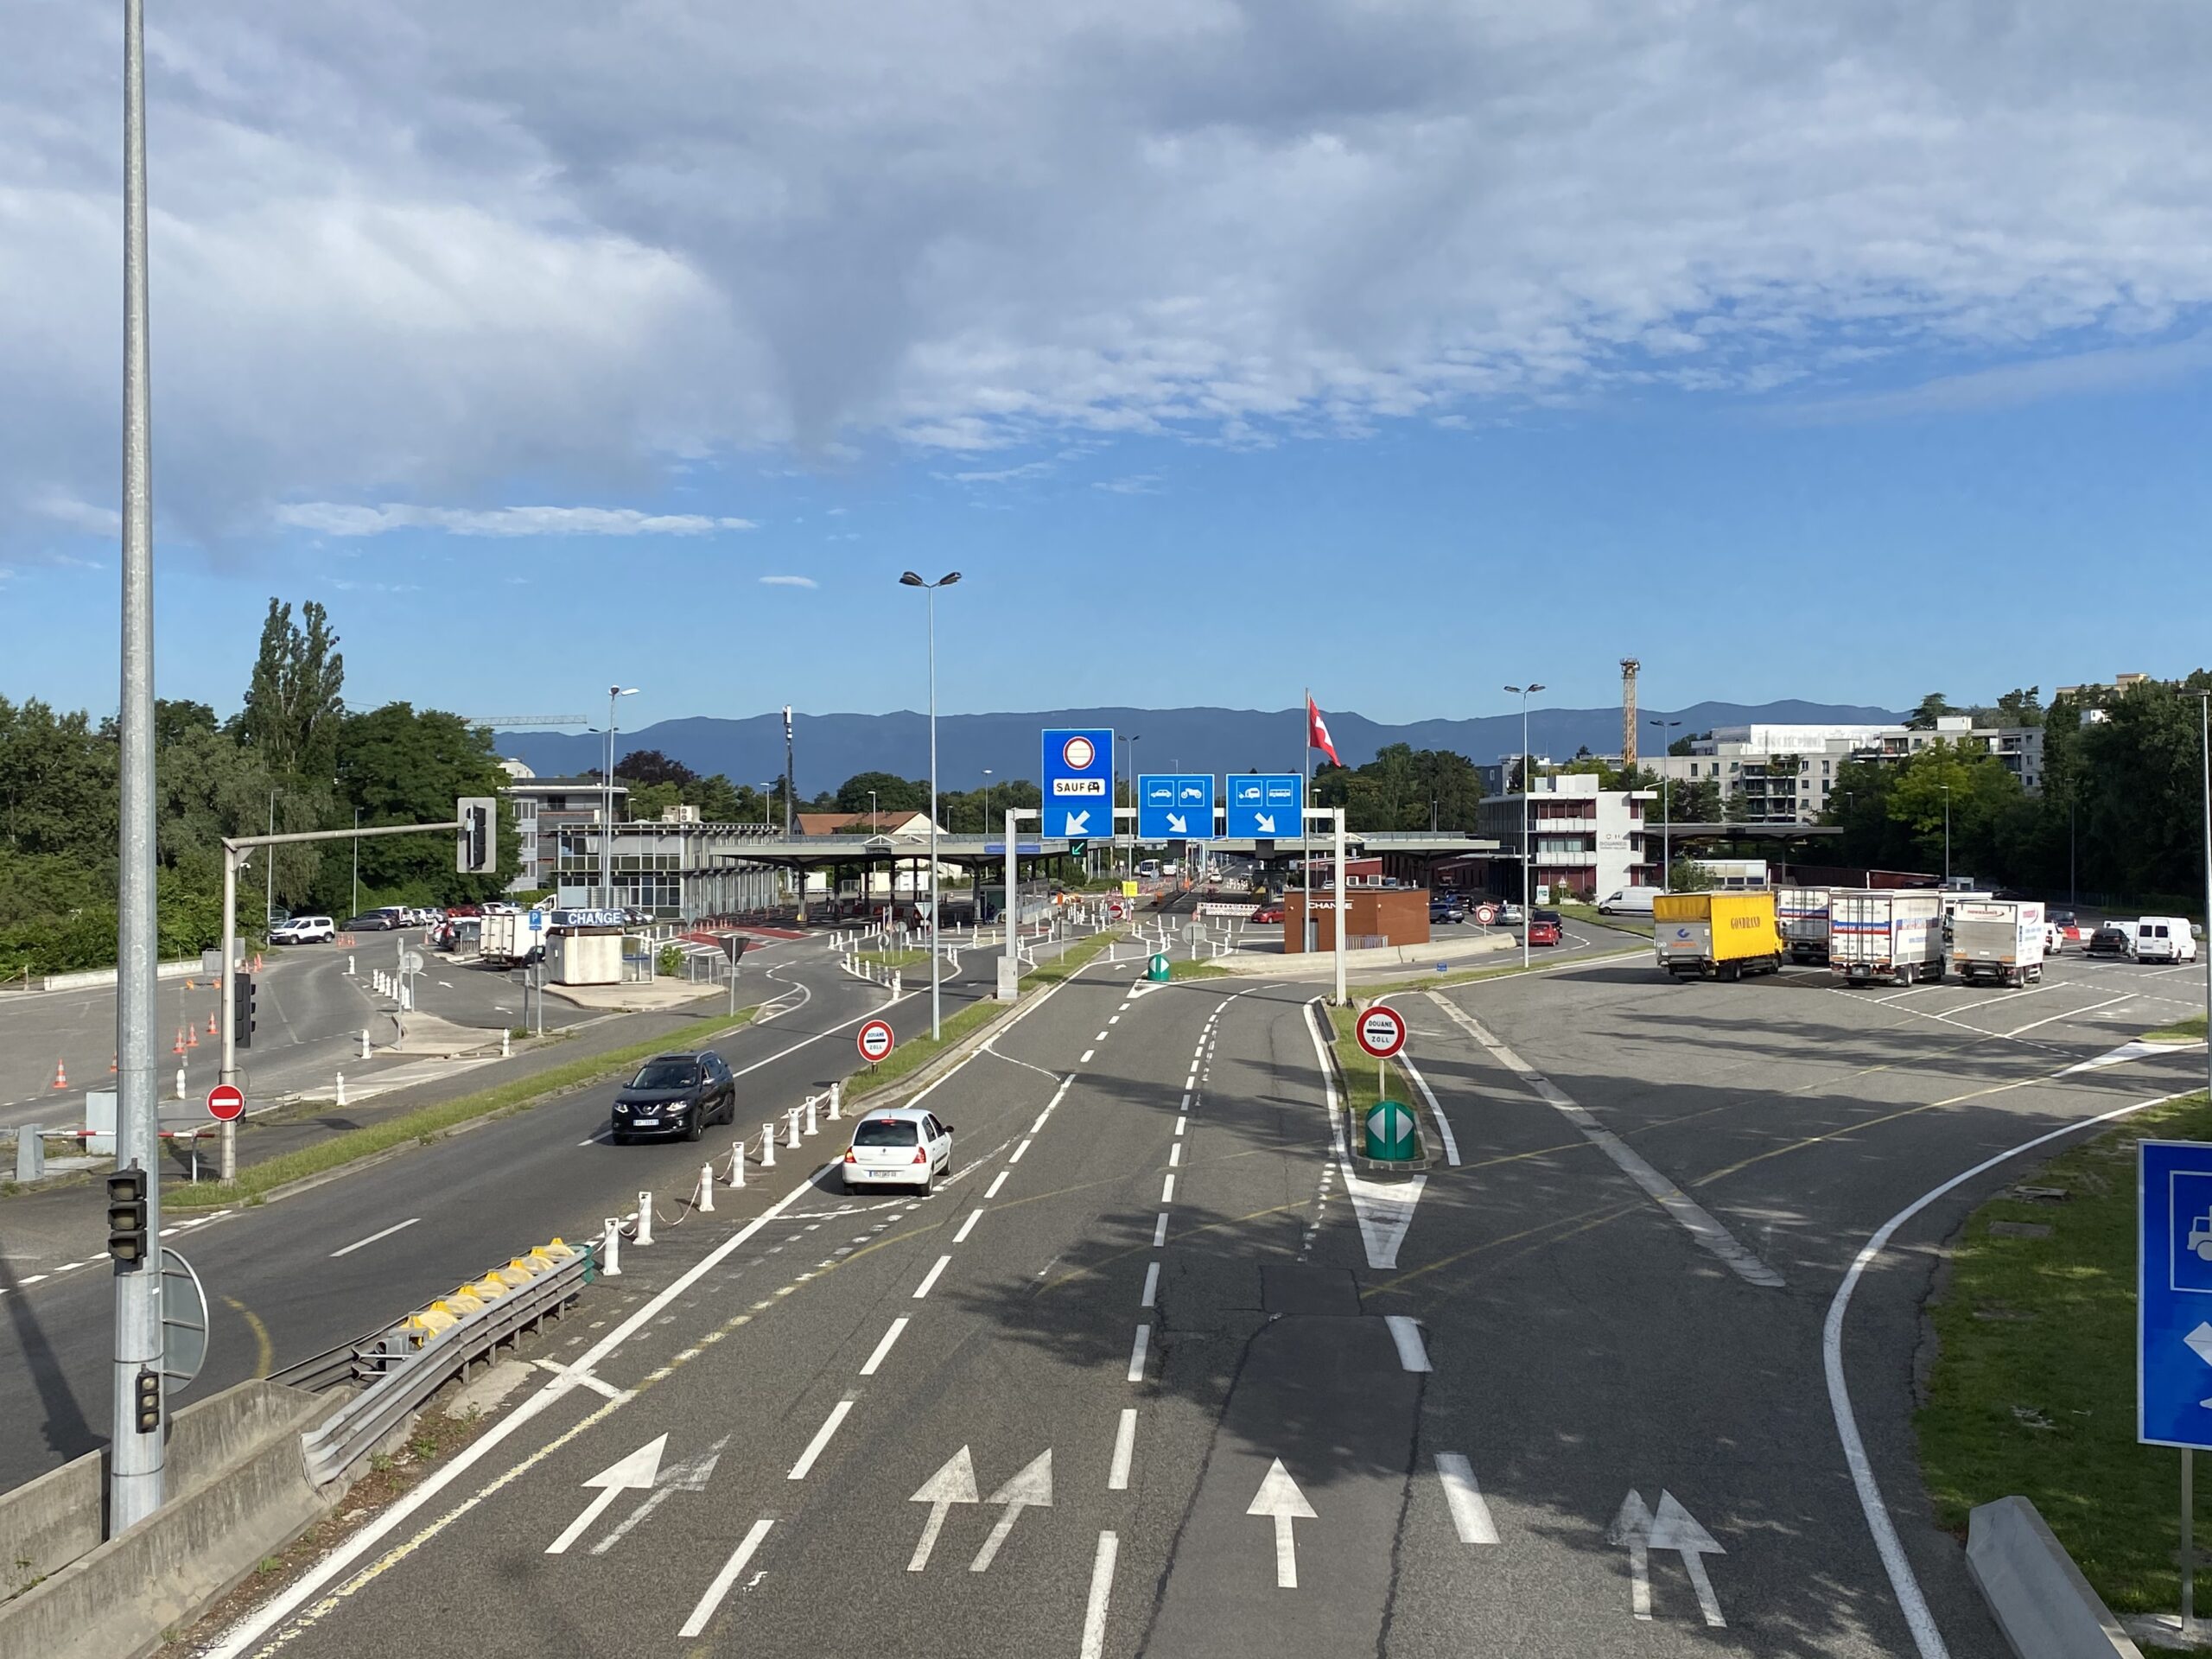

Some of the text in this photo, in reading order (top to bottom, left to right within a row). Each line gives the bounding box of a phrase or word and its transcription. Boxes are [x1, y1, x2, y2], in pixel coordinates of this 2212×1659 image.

[1056, 783, 1085, 792] SAUF
[531, 912, 539, 923] P
[568, 912, 621, 925] CHANGE
[1731, 916, 1760, 930] GONDRAND
